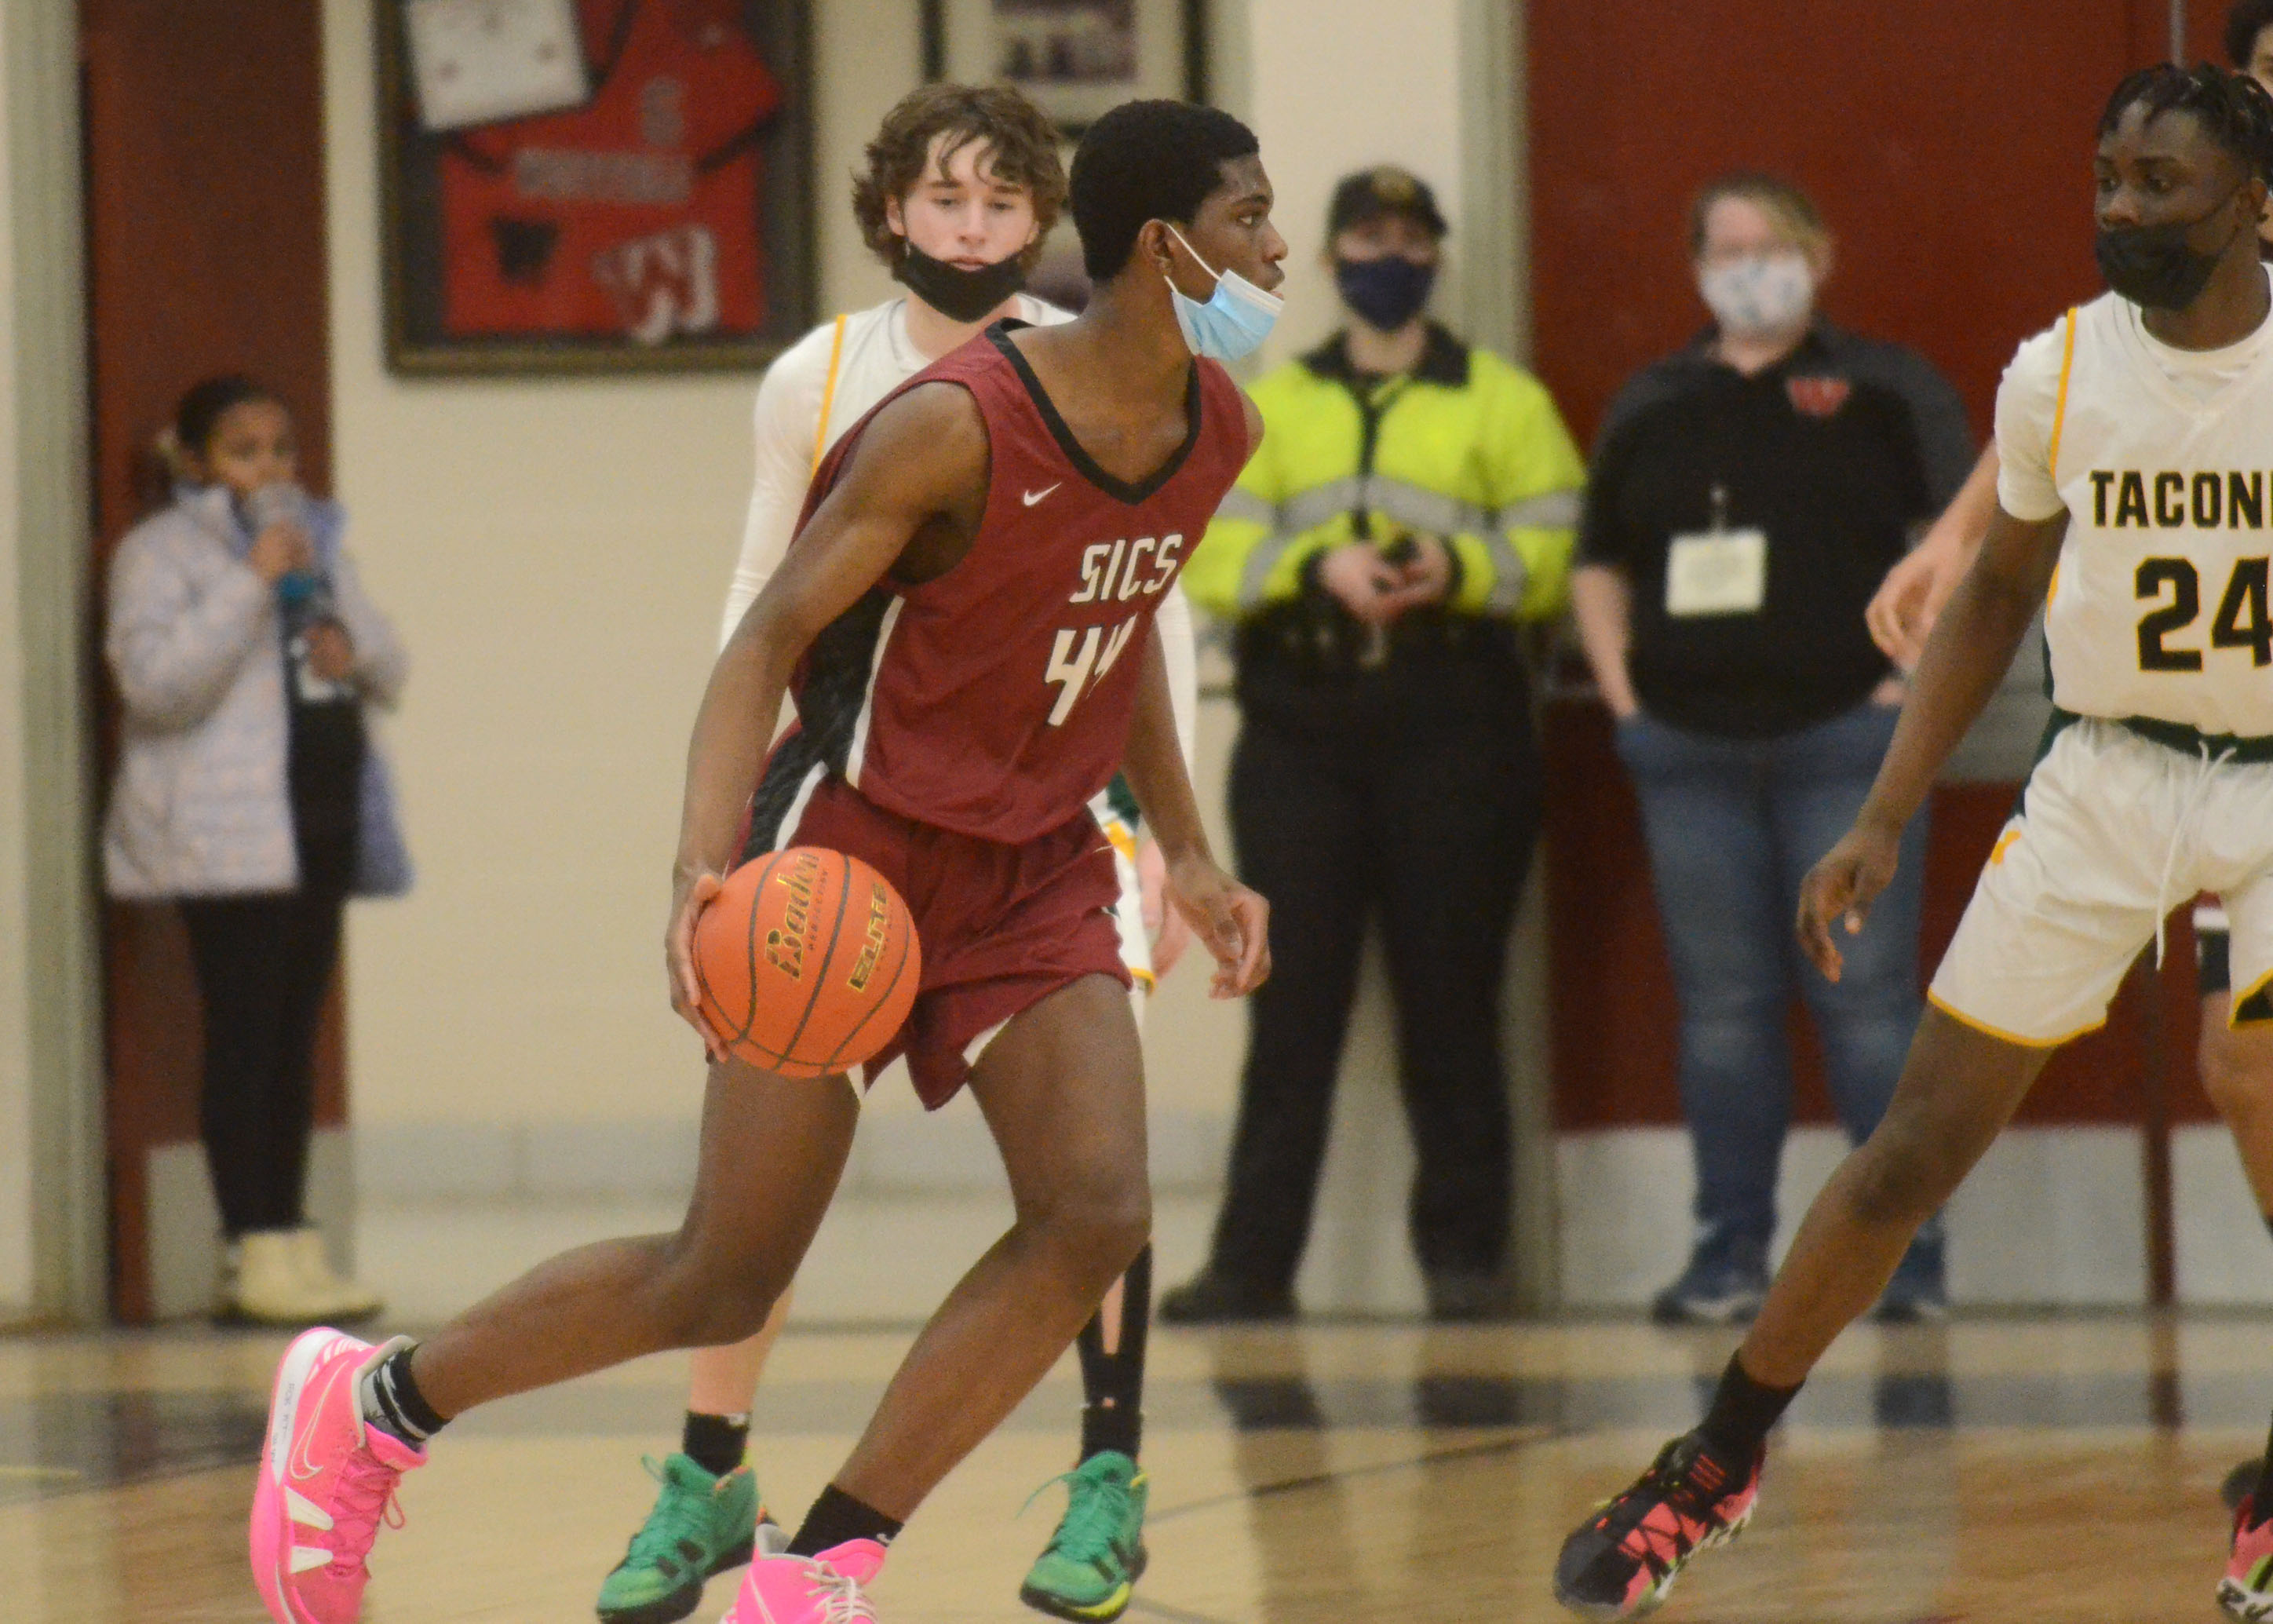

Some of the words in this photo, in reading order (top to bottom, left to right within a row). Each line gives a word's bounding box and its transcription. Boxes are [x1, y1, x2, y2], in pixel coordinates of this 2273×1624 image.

[2089, 469, 2273, 529] TACON
[1069, 533, 1182, 603] SICS
[2134, 555, 2273, 672] 24
